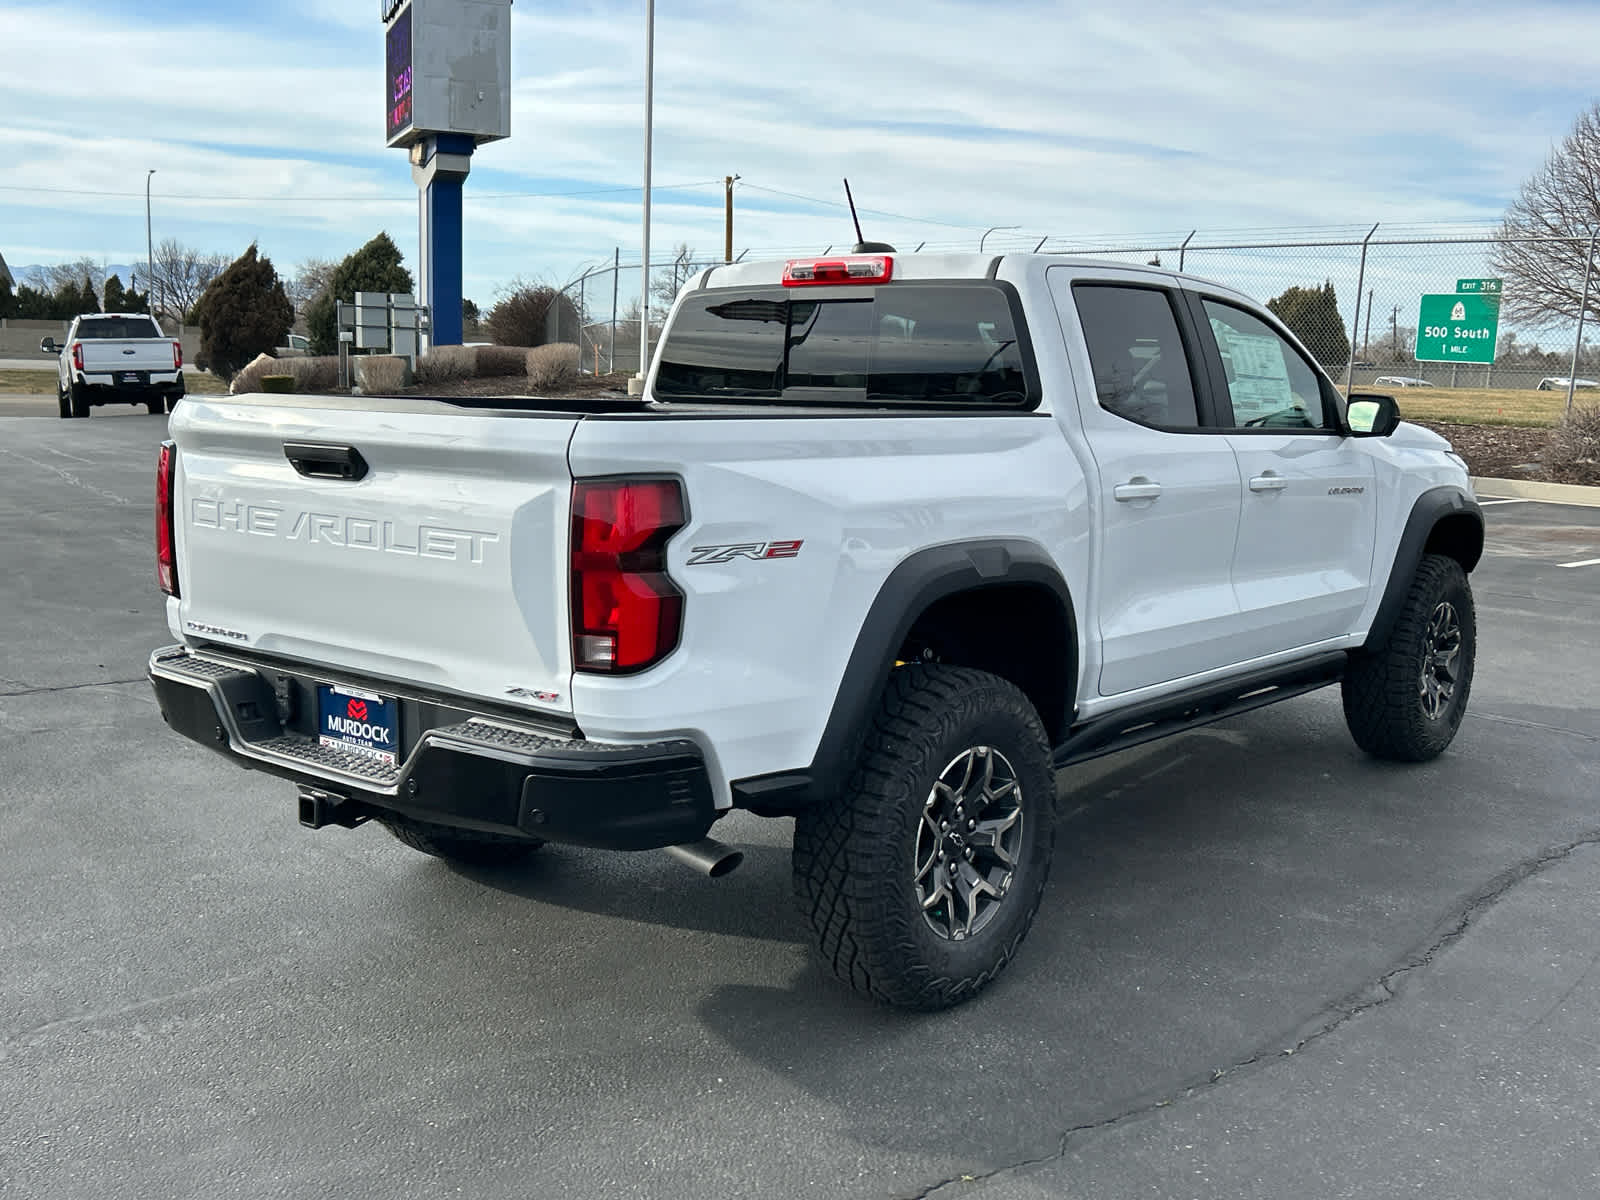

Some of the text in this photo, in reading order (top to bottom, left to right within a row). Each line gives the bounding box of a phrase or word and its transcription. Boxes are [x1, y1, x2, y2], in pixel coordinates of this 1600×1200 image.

[1462, 281, 1496, 291] EXIT 316
[1424, 326, 1489, 339] 500 South
[1442, 344, 1468, 355] 1 MILE
[192, 498, 499, 563] CHEVROLET
[686, 539, 804, 566] ZR2
[328, 714, 390, 744] MURDOCK
[358, 738, 373, 747] TEAM
